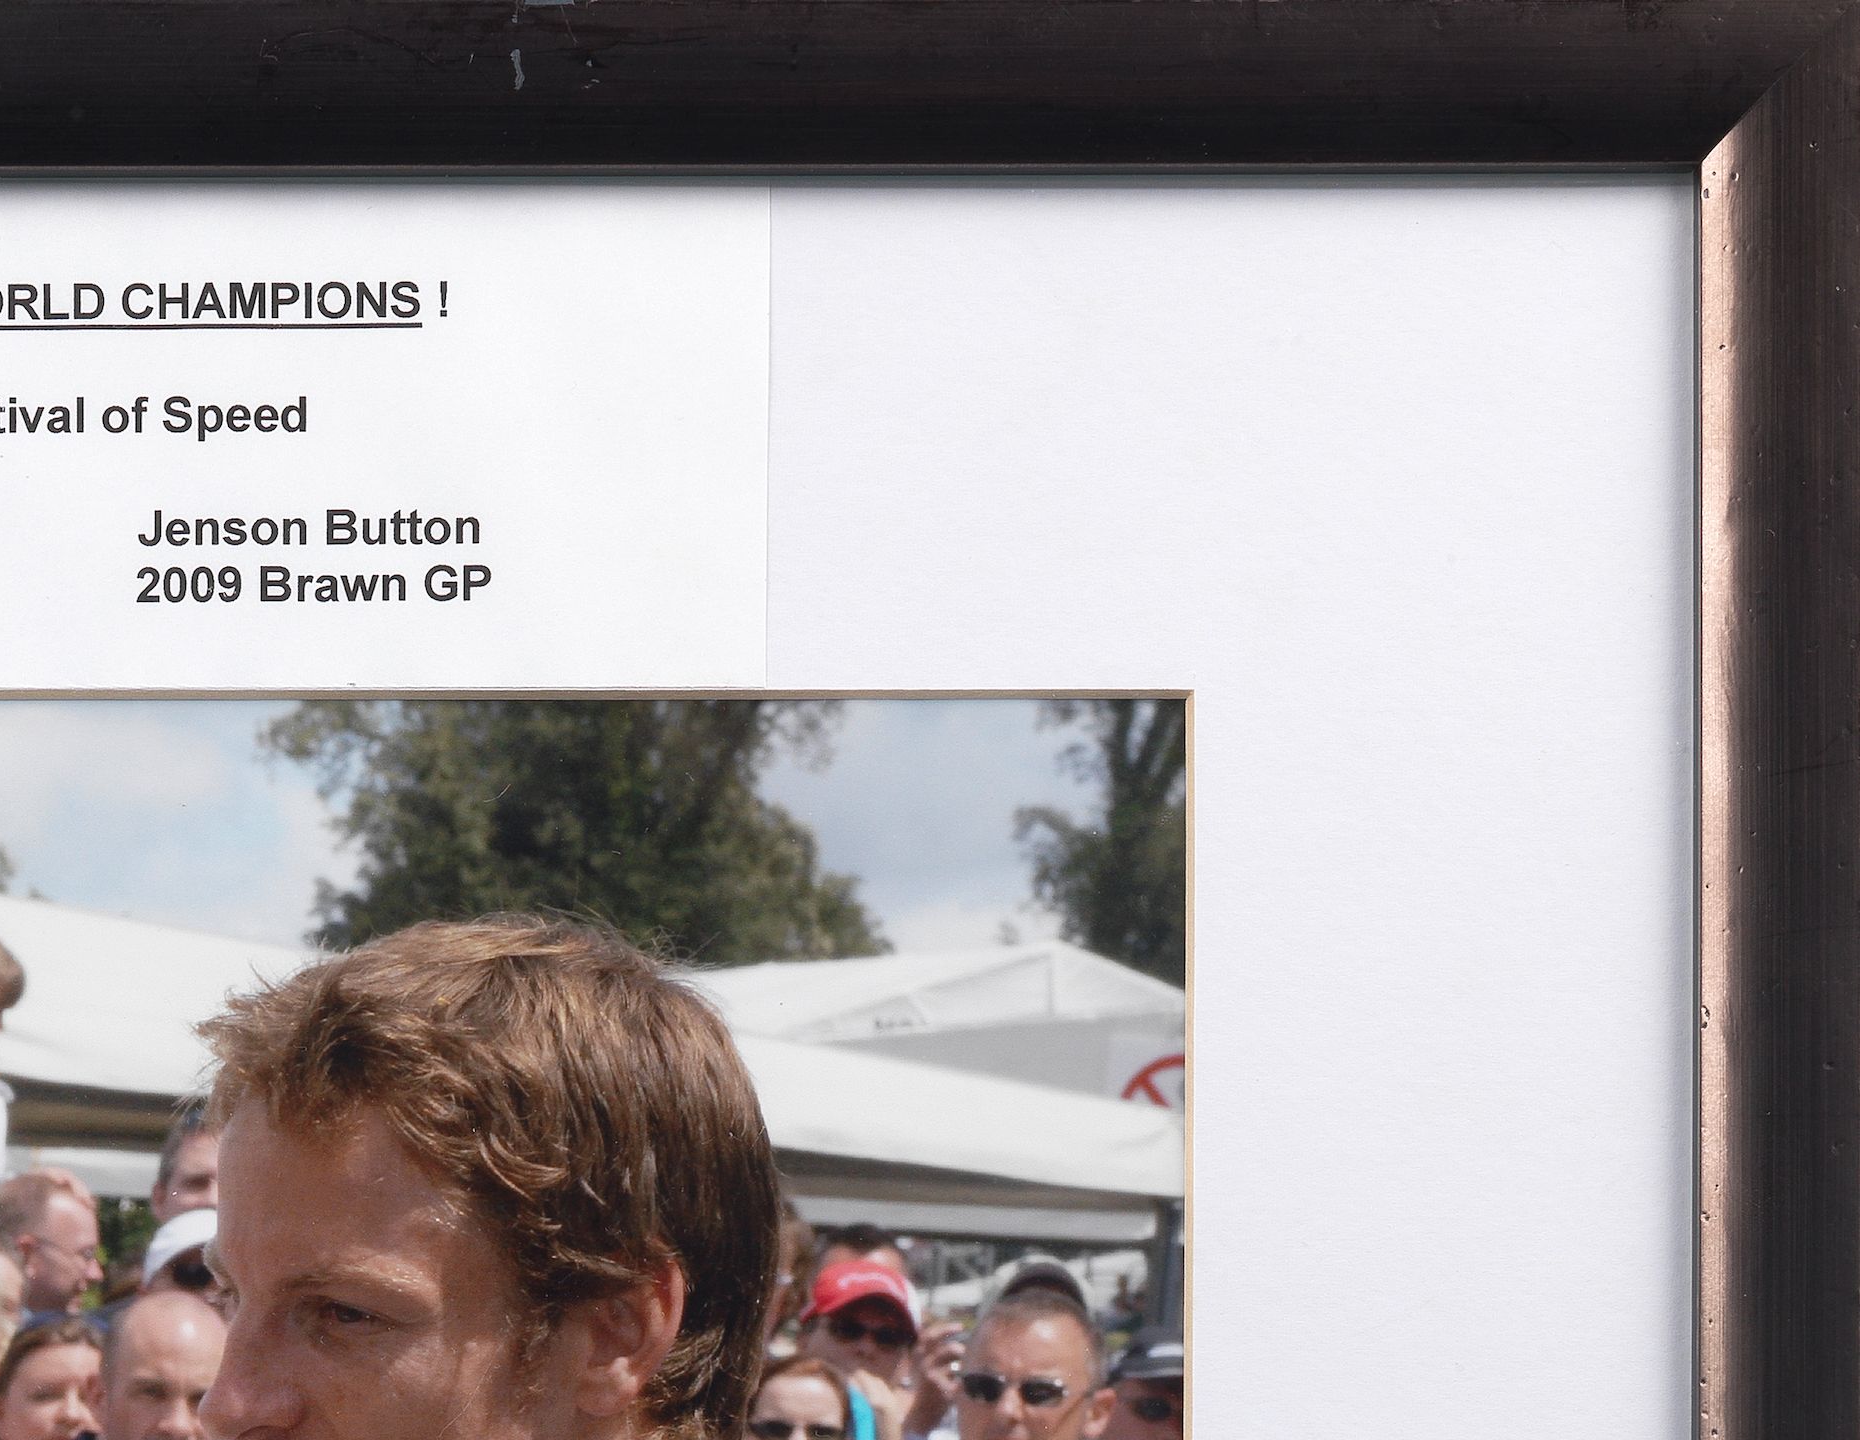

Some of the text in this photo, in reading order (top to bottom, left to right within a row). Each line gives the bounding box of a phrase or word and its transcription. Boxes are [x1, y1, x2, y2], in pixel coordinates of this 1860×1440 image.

[121, 280, 422, 320] CHAMPIONS
[438, 280, 449, 318] !
[101, 396, 149, 434] of
[162, 395, 307, 443] Speed
[136, 508, 480, 547] Jenson Button
[136, 563, 493, 604] 2009 Brawn GP
